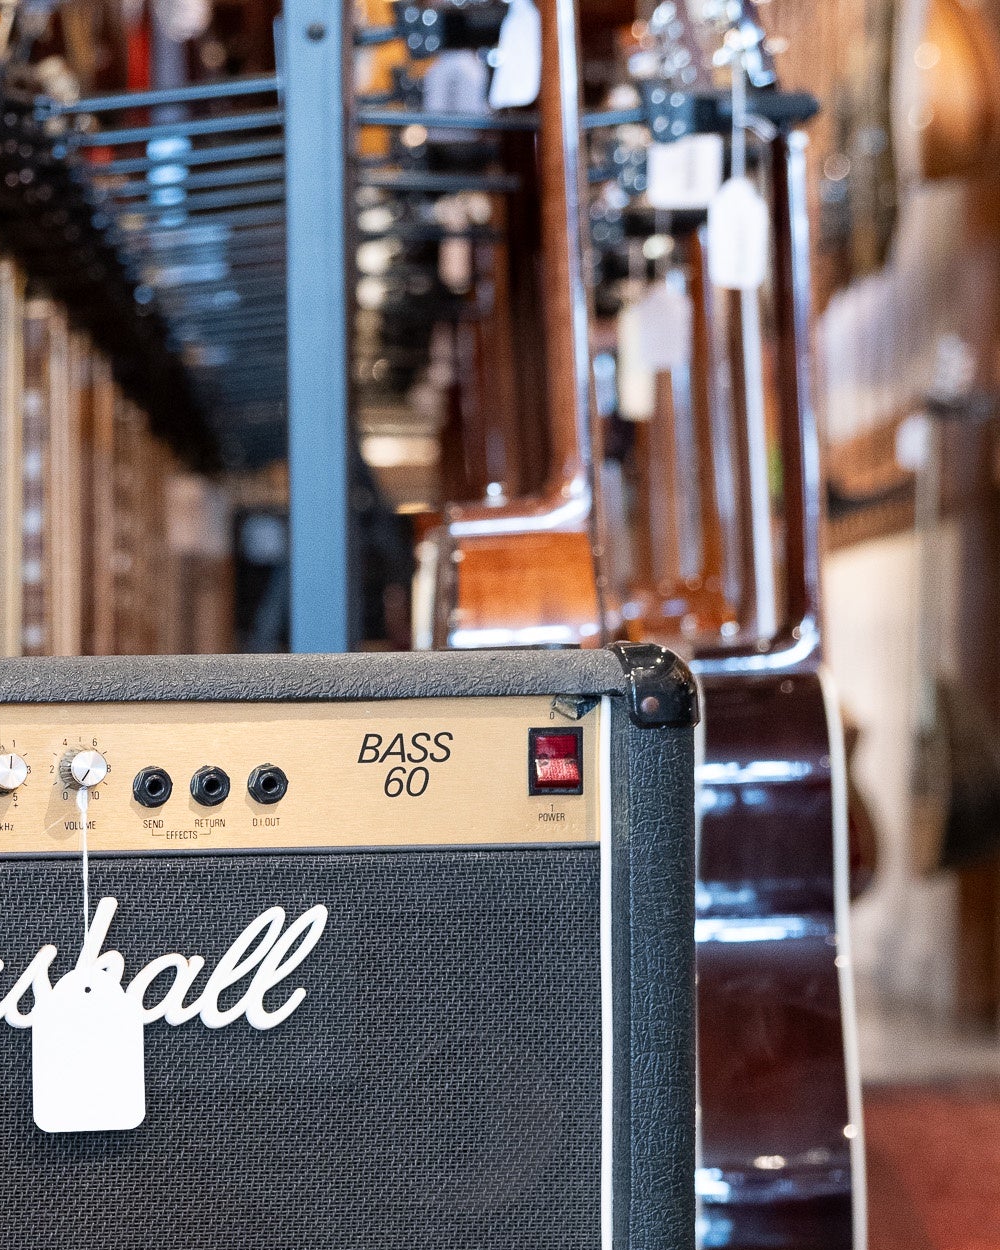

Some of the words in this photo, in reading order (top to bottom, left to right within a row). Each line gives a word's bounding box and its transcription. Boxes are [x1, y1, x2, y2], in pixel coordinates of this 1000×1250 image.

[62, 738, 68, 746] 4
[92, 737, 98, 747] 6
[357, 731, 454, 764] BASS
[26, 765, 32, 775] 3
[49, 764, 55, 774] 2
[106, 764, 112, 774] 8
[383, 766, 430, 798] 60
[12, 792, 18, 802] 5
[62, 791, 69, 801] 0
[91, 791, 100, 800] 10
[538, 812, 566, 822] POWER
[142, 819, 164, 829] SEND
[194, 818, 226, 828] RETURN
[166, 830, 198, 840] EFFECTS
